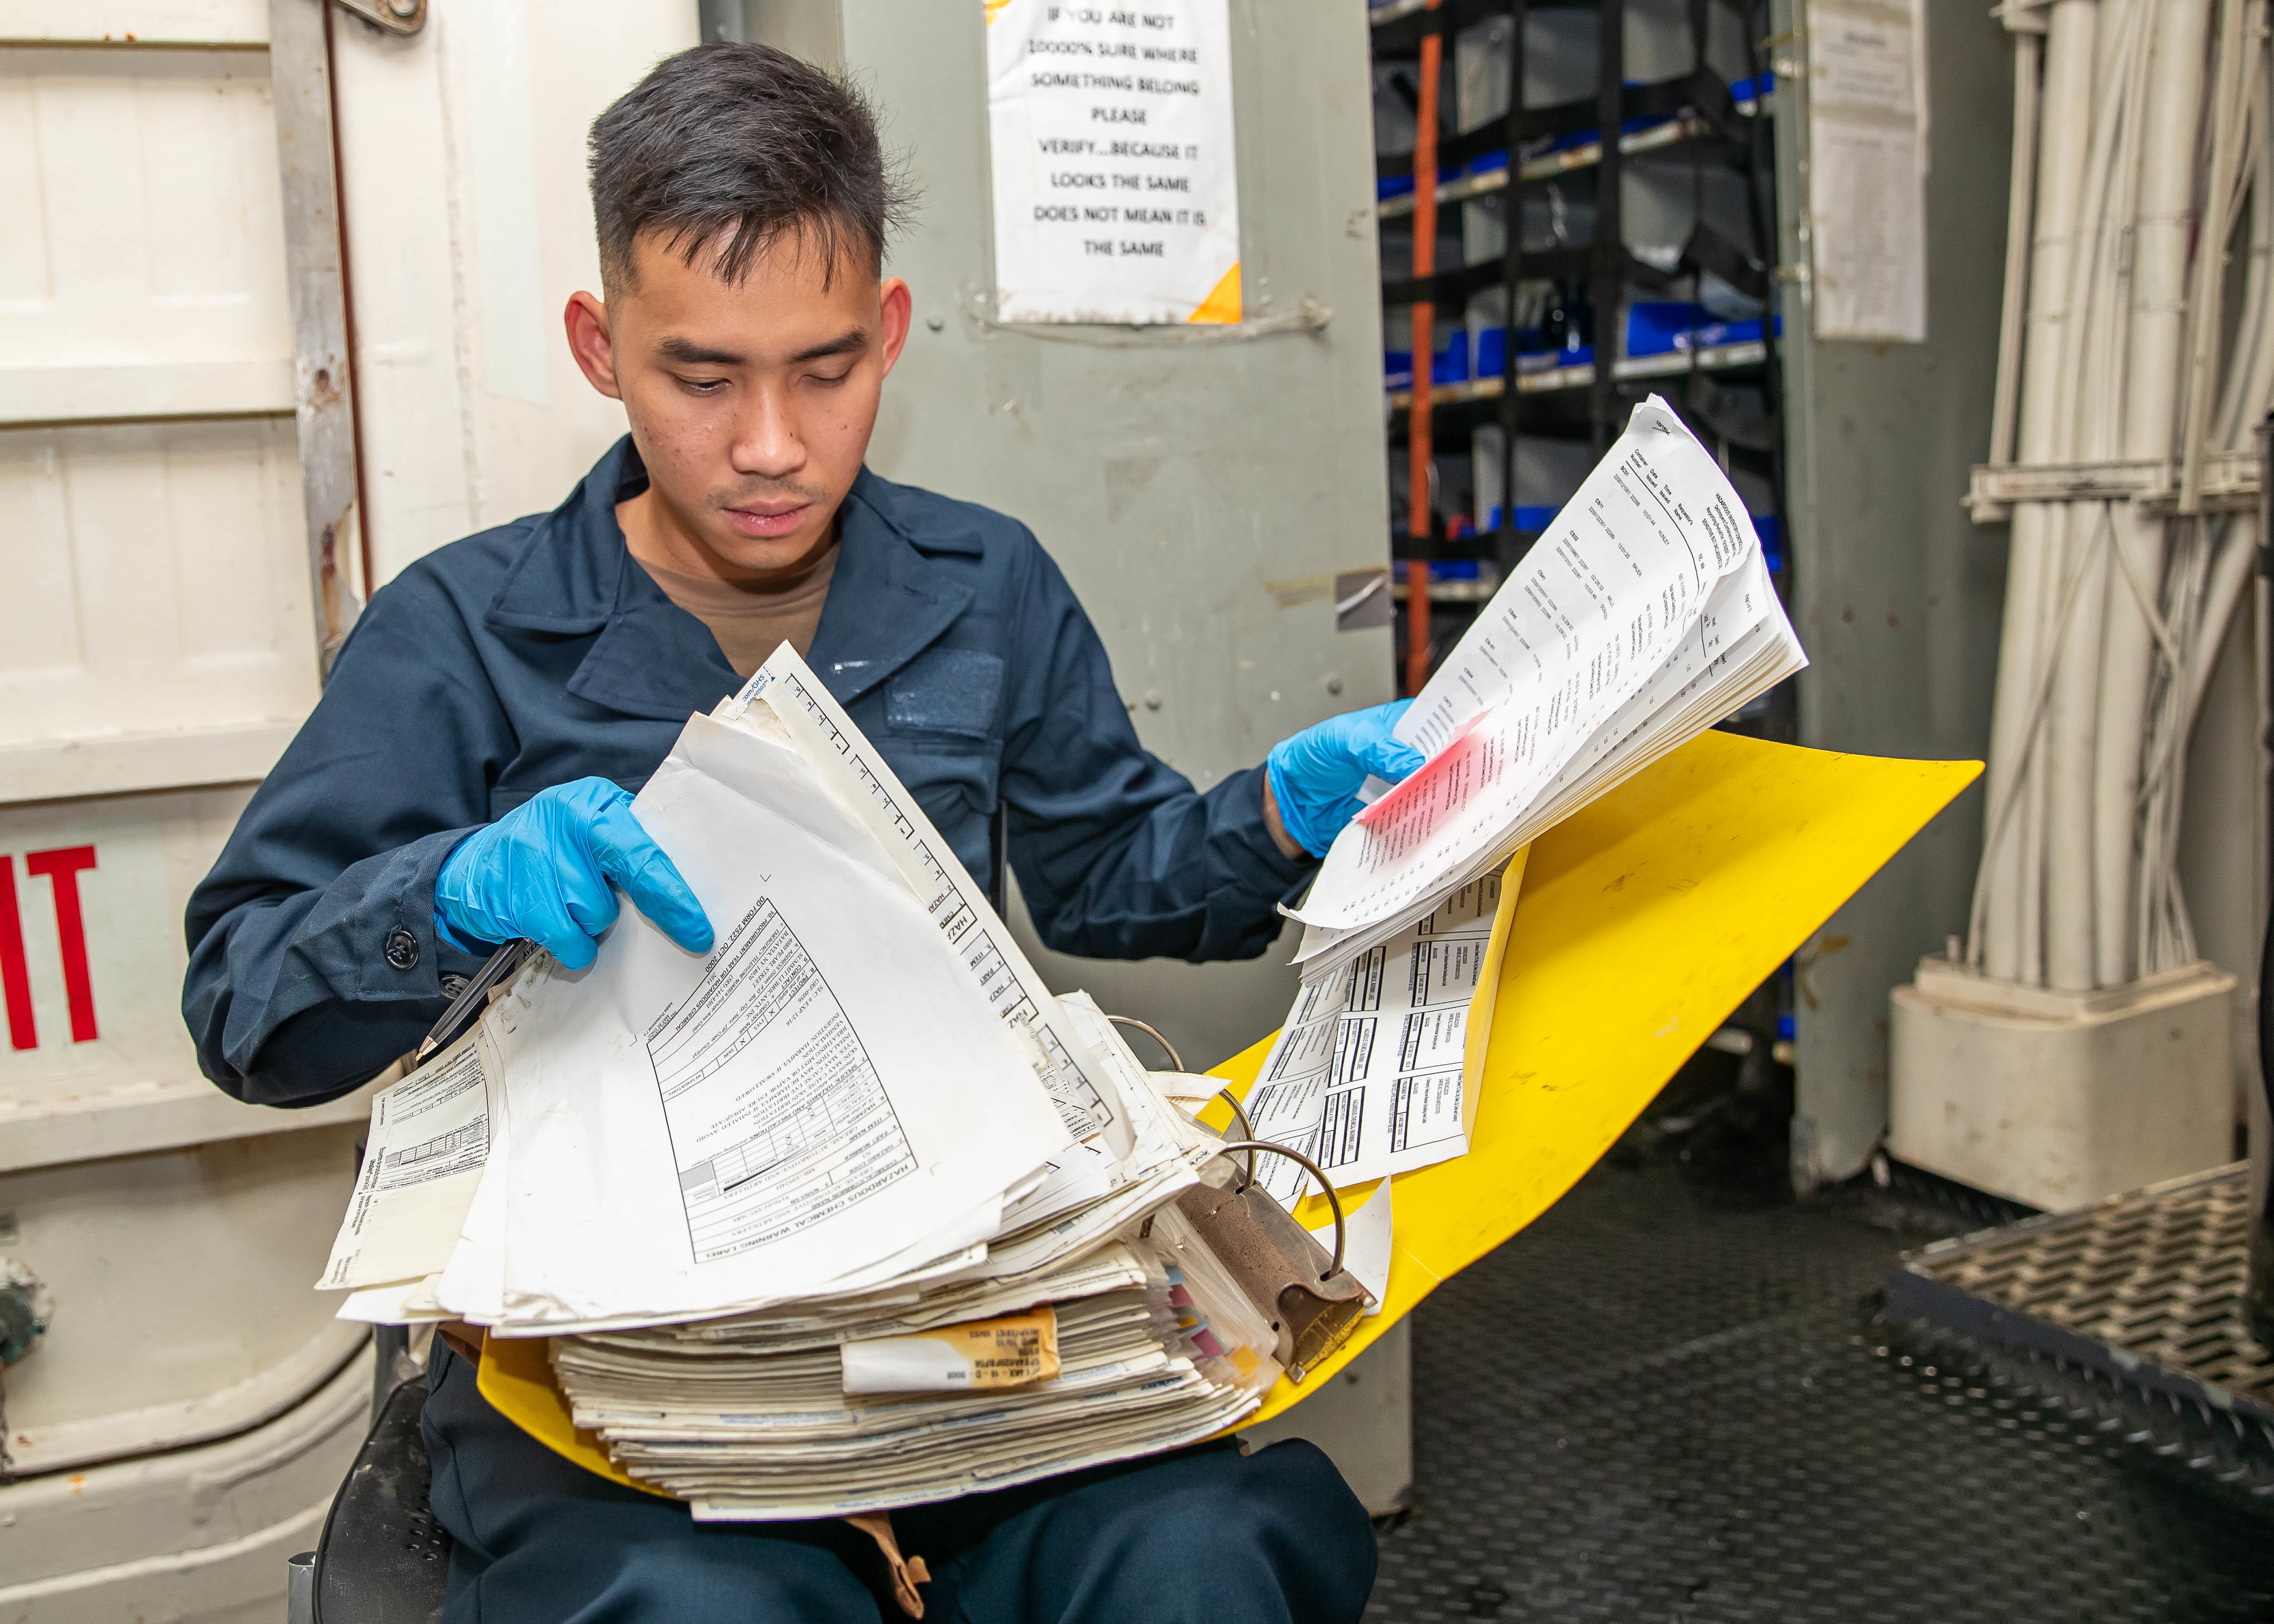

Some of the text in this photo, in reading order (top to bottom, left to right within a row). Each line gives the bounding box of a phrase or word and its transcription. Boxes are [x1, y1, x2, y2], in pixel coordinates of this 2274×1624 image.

[1048, 9, 1059, 21] IF
[1109, 10, 1136, 28] ARE
[1142, 12, 1175, 29] NOT
[1098, 42, 1136, 60] SURE
[1142, 47, 1198, 63] WHERE
[1031, 74, 1200, 96] SOMETHING BELONG
[1092, 108, 1147, 125] PLEASE
[1185, 144, 1198, 159] IT
[1051, 173, 1190, 192] LOOKS THE SAME
[1033, 206, 1077, 222] DOES
[1084, 207, 1118, 223] NOT
[1125, 208, 1172, 224] MEAN
[1177, 209, 1190, 224] IT
[1084, 240, 1165, 257] THE SAME
[1633, 448, 1650, 466] Container
[1649, 468, 1659, 479] Date
[1662, 484, 1673, 495] Time
[1629, 453, 1683, 521] Number Issued Issued Name
[703, 895, 766, 973] DD FORM 2522, OCT 2000
[750, 937, 794, 989] 4080 PEARL STREET
[758, 956, 768, 967] NY
[775, 948, 794, 970] ADDRESS
[782, 951, 804, 976] SUMMIT
[674, 910, 775, 1032] 10. PROCUREMENT YEAR FOR HAZARDOUS CHEMICAL
[705, 971, 717, 986] 2014
[747, 965, 761, 981] 14020
[690, 928, 779, 1034] EMERGENCY TELEPHONE NUMBER (Include Area Code)
[721, 974, 734, 989] (585)
[796, 977, 820, 1003] GRF-0056
[662, 1000, 674, 1013] Adobe
[737, 963, 802, 1036] CONTACT COMPANY NAME
[797, 1000, 810, 1014] EXP
[646, 1011, 665, 1032] Professional
[743, 1008, 755, 1021] INC
[785, 1012, 799, 1027] 12/16
[667, 974, 809, 1096] PROTECT EYES SKIN RESPIRATORY
[813, 1025, 848, 1058] BREATHING
[690, 1041, 710, 1059] Country)
[781, 1041, 810, 1068] HARMFUL
[799, 1055, 815, 1070] MIST
[822, 1053, 838, 1068] MAY
[826, 1059, 842, 1074] MAY
[790, 1067, 800, 1077] OR
[799, 1064, 814, 1079] MAY
[801, 1065, 824, 1085] CAUSE
[789, 1078, 798, 1086] BE
[805, 1072, 827, 1091] CAUSE
[758, 1084, 790, 1108] HARMFUL
[790, 1088, 807, 1102] SKIN
[752, 1092, 790, 1120] IRRITATION
[752, 1099, 791, 1127] IRRITATION
[791, 1103, 806, 1114] AND
[709, 1106, 746, 1130] ADEQUATE
[695, 1129, 720, 1143] AVOID
[848, 1116, 883, 1142] ITEM NAME
[871, 1130, 888, 1144] PART
[703, 1164, 909, 1260] HAZARDOUS CHEMICAL WARNING LABEL
